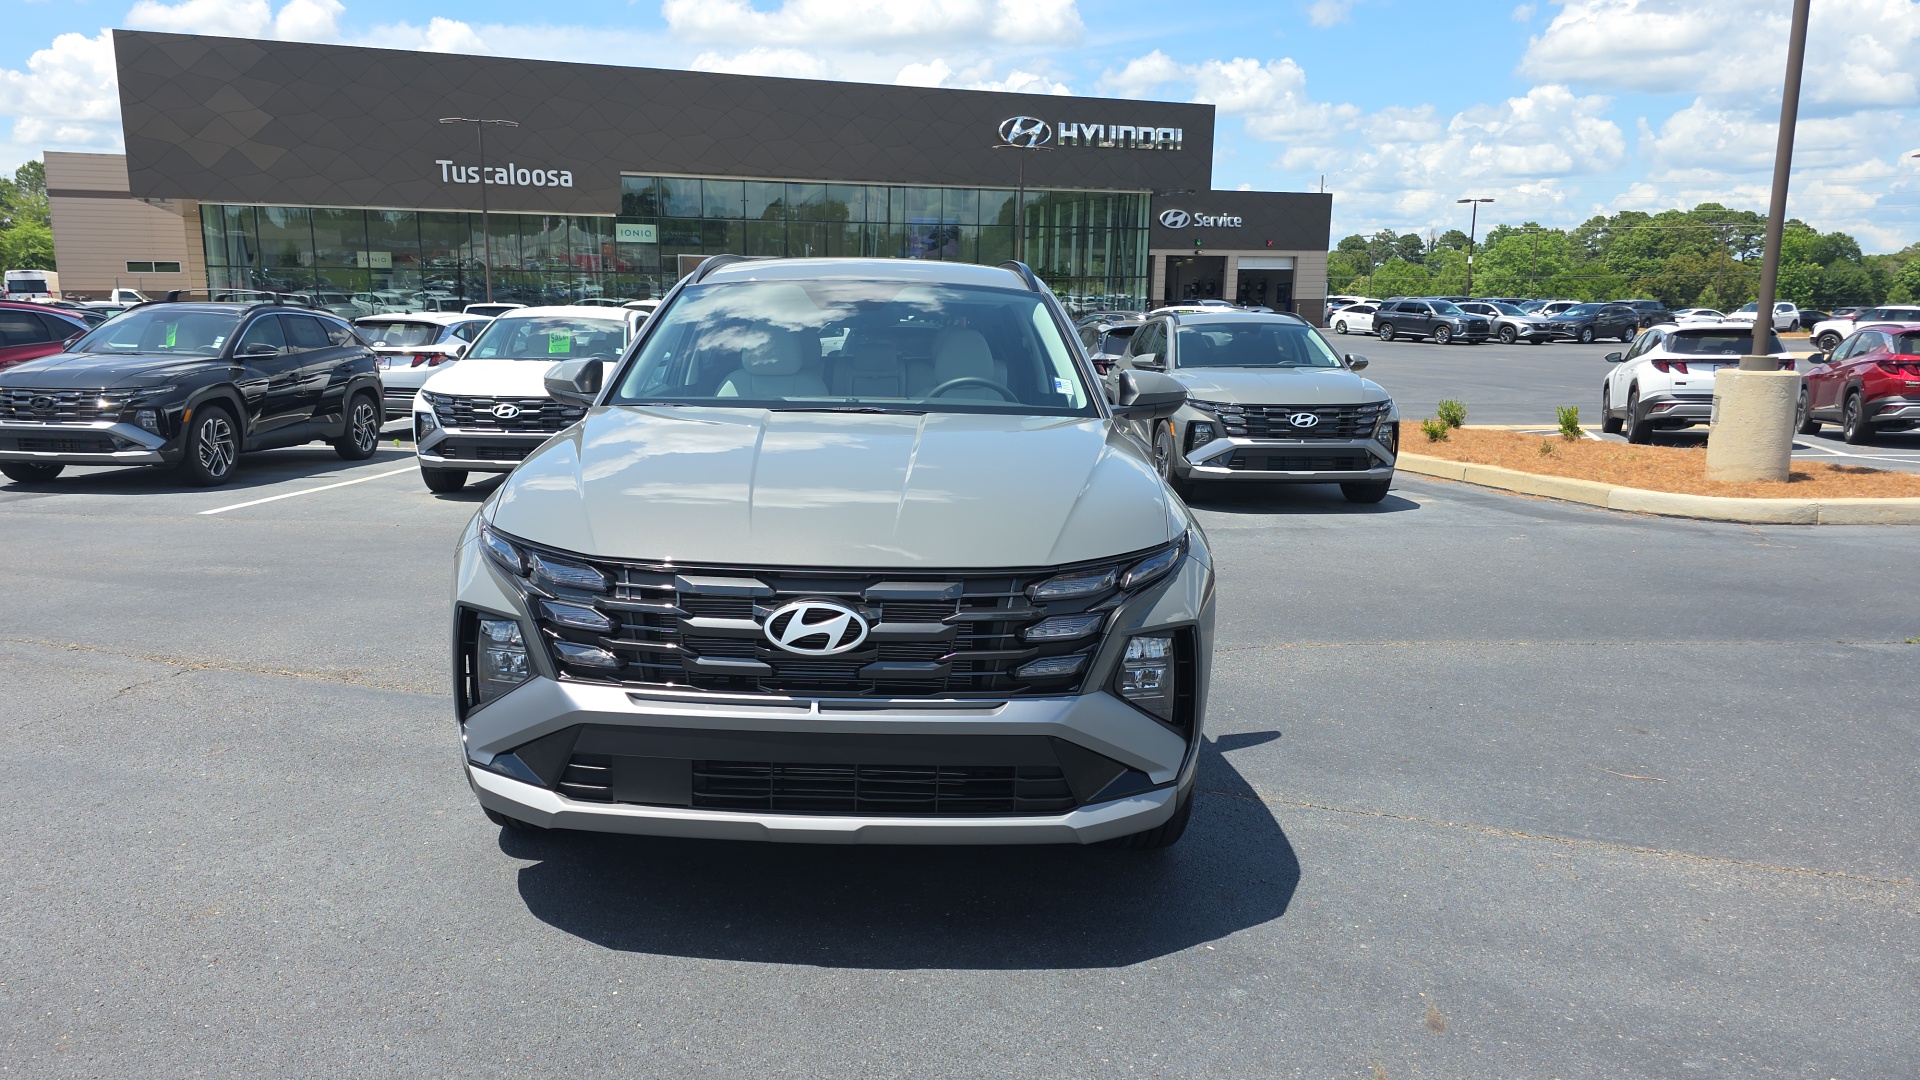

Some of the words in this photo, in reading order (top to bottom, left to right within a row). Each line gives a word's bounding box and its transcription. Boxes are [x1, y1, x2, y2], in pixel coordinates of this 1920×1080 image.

[1057, 121, 1183, 150] HYUNDAI
[435, 159, 573, 188] Tuscaloosa
[1193, 212, 1242, 228] Service
[620, 229, 652, 238] IONIQ
